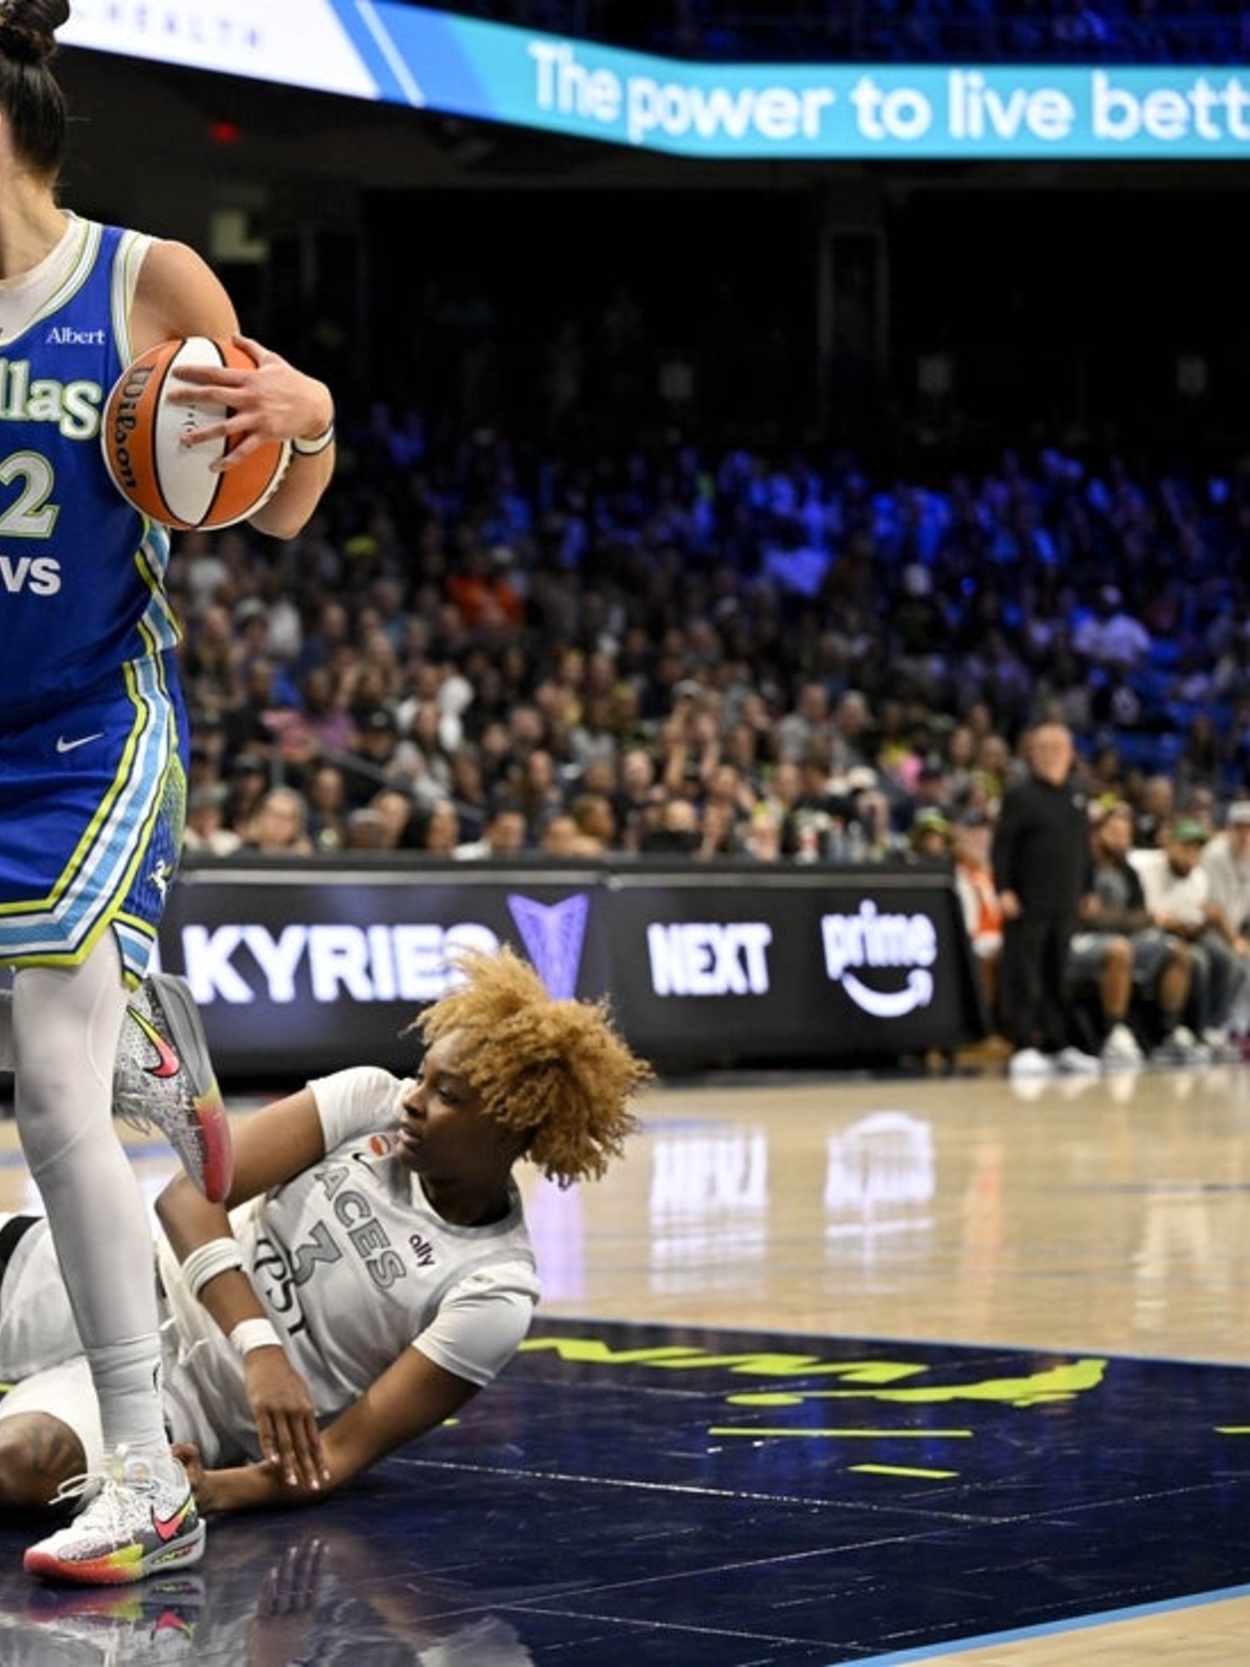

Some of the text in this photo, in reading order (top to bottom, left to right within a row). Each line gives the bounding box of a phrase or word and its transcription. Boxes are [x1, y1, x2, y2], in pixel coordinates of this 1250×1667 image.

[528, 41, 621, 123] The
[627, 76, 835, 144] power
[850, 76, 932, 140] to
[949, 69, 1075, 140] live
[46, 327, 105, 344] Albert
[115, 364, 156, 489] Wilson
[648, 923, 772, 996] NEXT
[821, 899, 937, 980] prime
[291, 1220, 343, 1288] 3
[315, 1166, 407, 1290] ACES
[409, 1233, 437, 1268] ally
